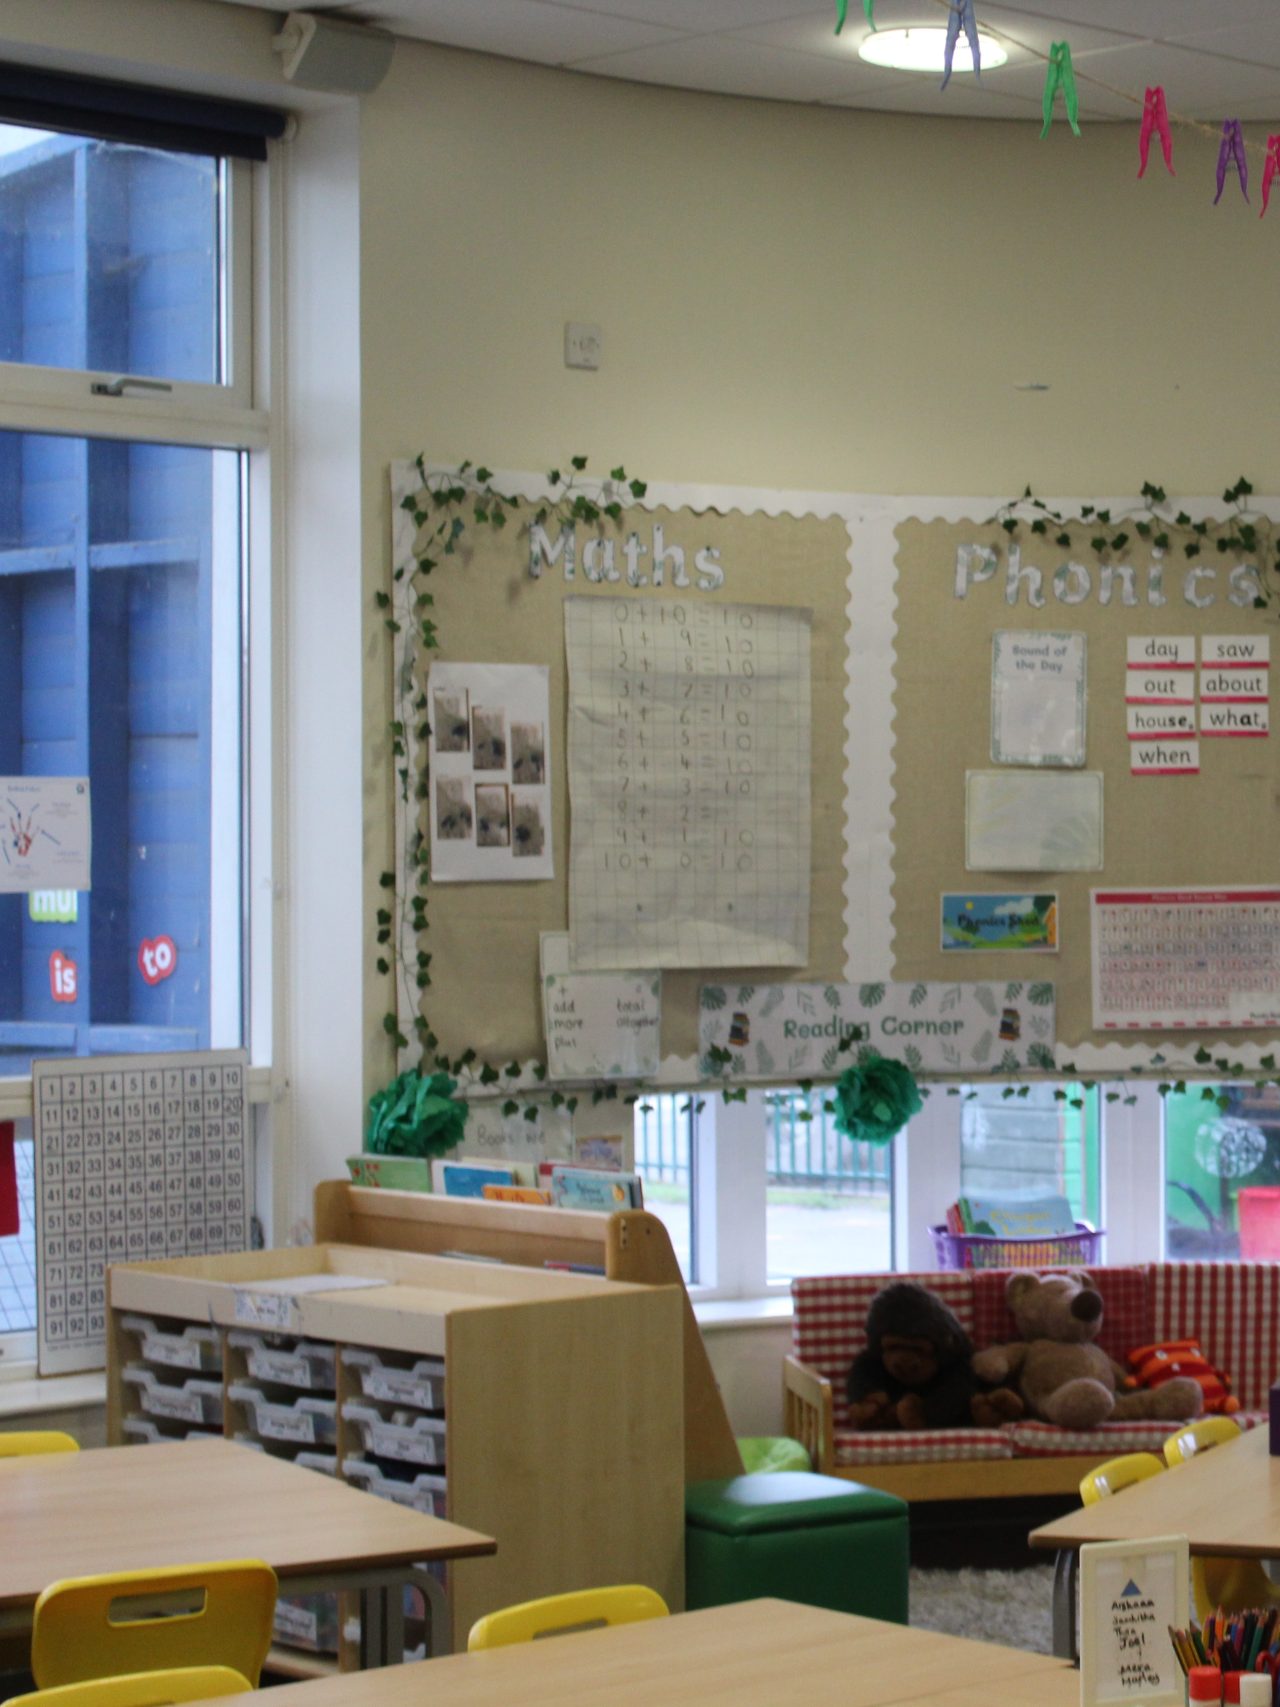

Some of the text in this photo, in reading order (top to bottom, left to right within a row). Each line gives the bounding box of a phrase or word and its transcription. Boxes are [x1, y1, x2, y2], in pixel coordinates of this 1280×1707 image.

[528, 521, 725, 591] Maths
[954, 543, 1260, 608] Phonics
[1054, 645, 1067, 656] of
[1145, 639, 1254, 662] day saw
[1016, 660, 1063, 673] the Day
[1144, 673, 1262, 693] out about
[1135, 708, 1259, 729] house what
[1139, 745, 1191, 764] when
[142, 942, 172, 977] to
[54, 959, 75, 994] is
[783, 1013, 965, 1042] Reading Corner
[49, 1069, 240, 1096] 1 2 3 4 5 6 7 8 9 10
[45, 1108, 58, 1123] 11
[66, 1107, 78, 1122] 12
[86, 1105, 100, 1120] 13
[107, 1105, 119, 1117] 14
[127, 1103, 141, 1117] 15
[148, 1101, 160, 1115] 16
[168, 1100, 180, 1114] 17
[188, 1099, 202, 1113] 18
[207, 1097, 222, 1110] 19
[45, 1121, 239, 1149] 21 22 23 24 25 26 27 28 29 30
[47, 1146, 240, 1176] 31 32 33 34 35 36 37 38 39 40
[47, 1172, 241, 1201] 41 42 43 44 45 46 47 48 49 50
[50, 1263, 103, 1281] 71 72 73
[49, 1289, 104, 1308] 81 82 83
[50, 1315, 104, 1334] 91 92 93
